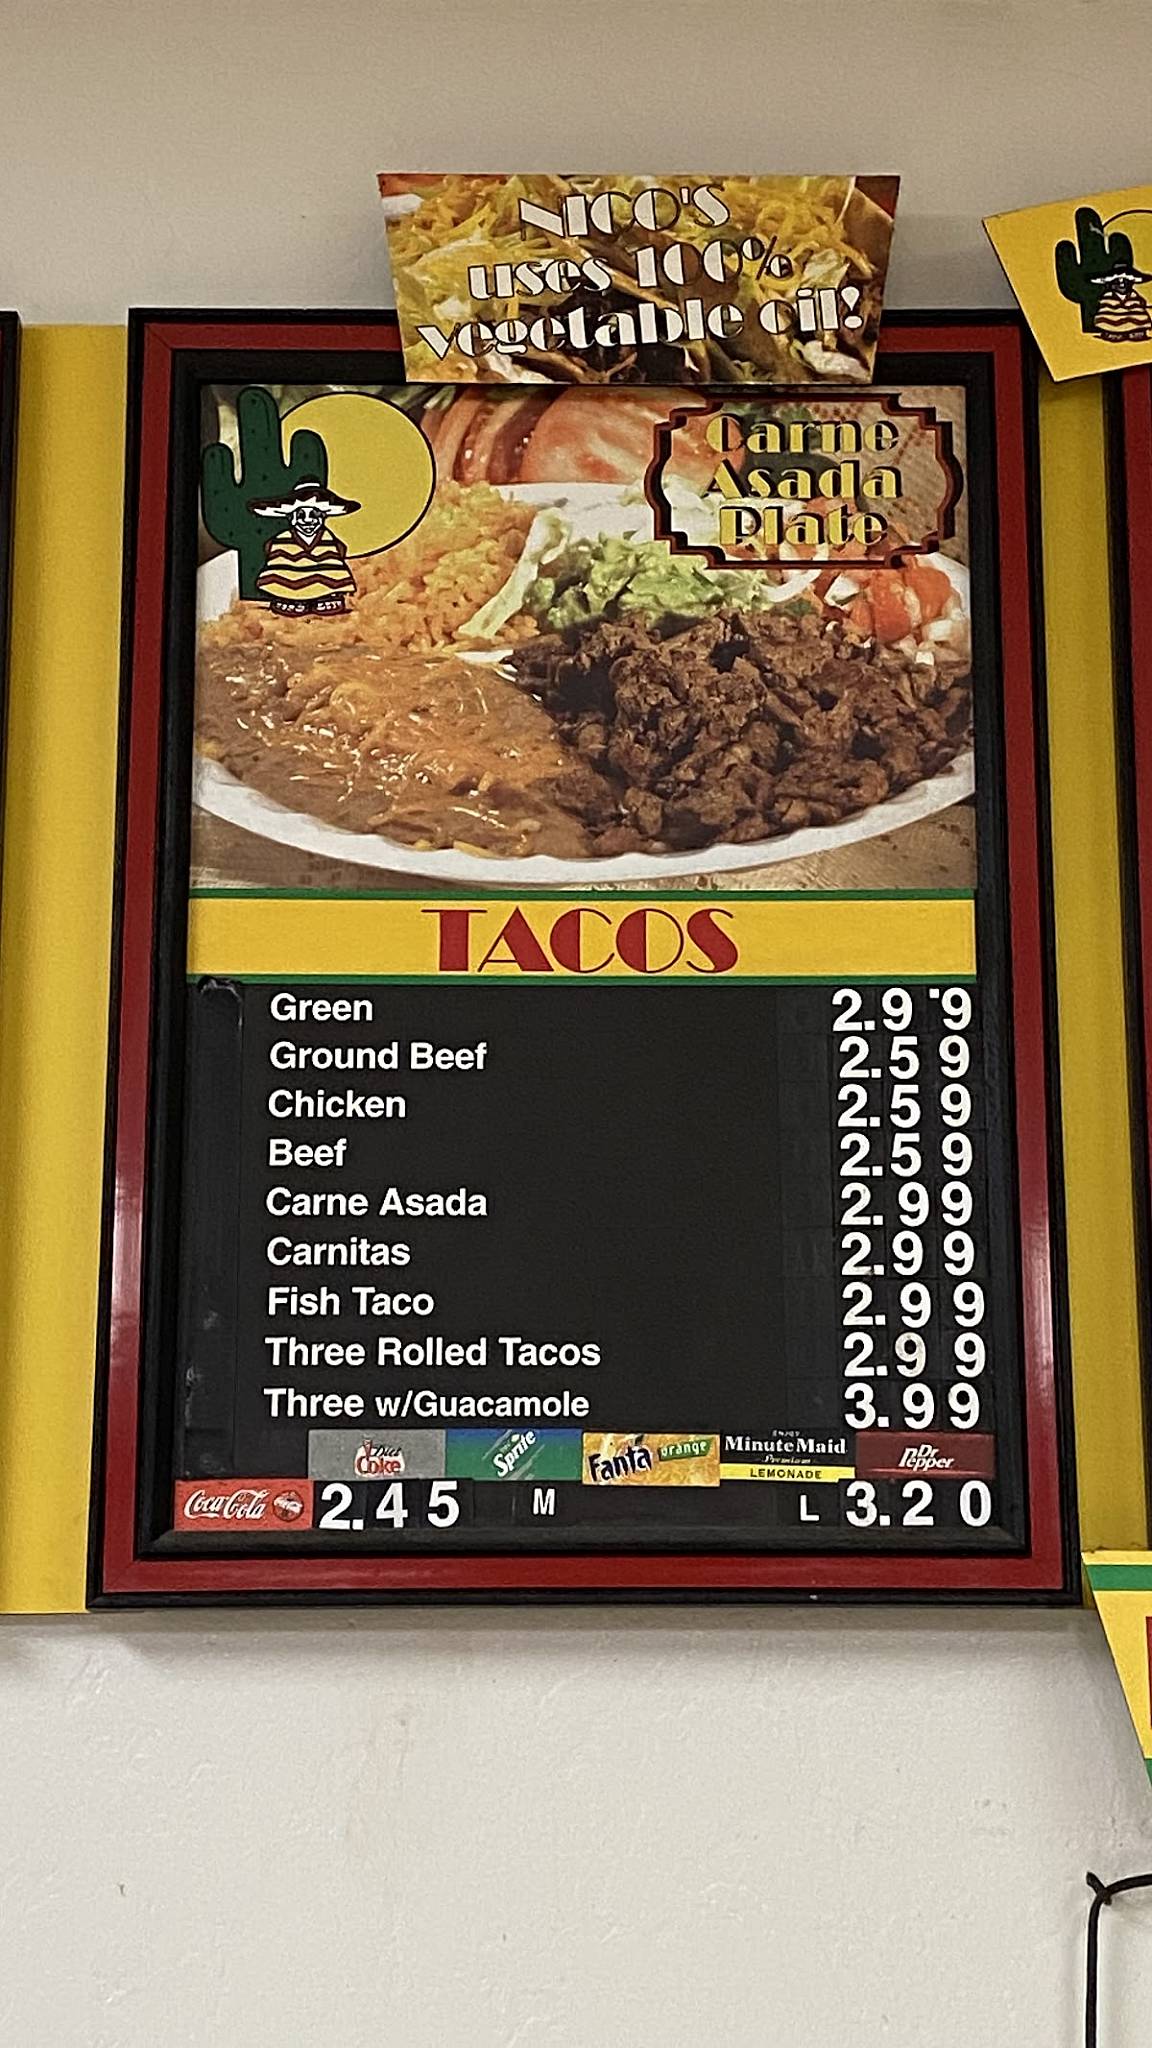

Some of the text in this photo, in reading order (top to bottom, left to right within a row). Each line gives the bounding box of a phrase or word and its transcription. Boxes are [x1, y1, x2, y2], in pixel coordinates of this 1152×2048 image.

[518, 183, 730, 241] NICO'S
[467, 236, 793, 301] uses 100%
[417, 284, 864, 361] vegetable oil!
[705, 413, 900, 453] Carne
[702, 458, 903, 499] Asada
[718, 504, 889, 546] Plate
[421, 907, 738, 974] TACOS
[270, 992, 373, 1021] Green
[269, 1040, 488, 1070] Ground Beef
[268, 1089, 406, 1118] Chicken
[268, 1137, 347, 1167] Beef
[266, 1186, 488, 1217] Carne Asada
[267, 1236, 411, 1266] Carnitas
[268, 1286, 435, 1316] Fish Taco
[264, 1336, 601, 1366] Three Rolled Tacos
[263, 1387, 590, 1418] Three w/Guacamole
[493, 1431, 537, 1478] Sprite
[661, 1440, 707, 1457] orange
[725, 1436, 847, 1454] Minute Maid
[899, 1447, 954, 1472] Pepper
[921, 1444, 948, 1458] Dr
[356, 1455, 401, 1475] Coke
[589, 1445, 652, 1482] Fanta
[750, 1468, 823, 1479] LEMONADE
[532, 1488, 556, 1516] M
[800, 1494, 820, 1522] L
